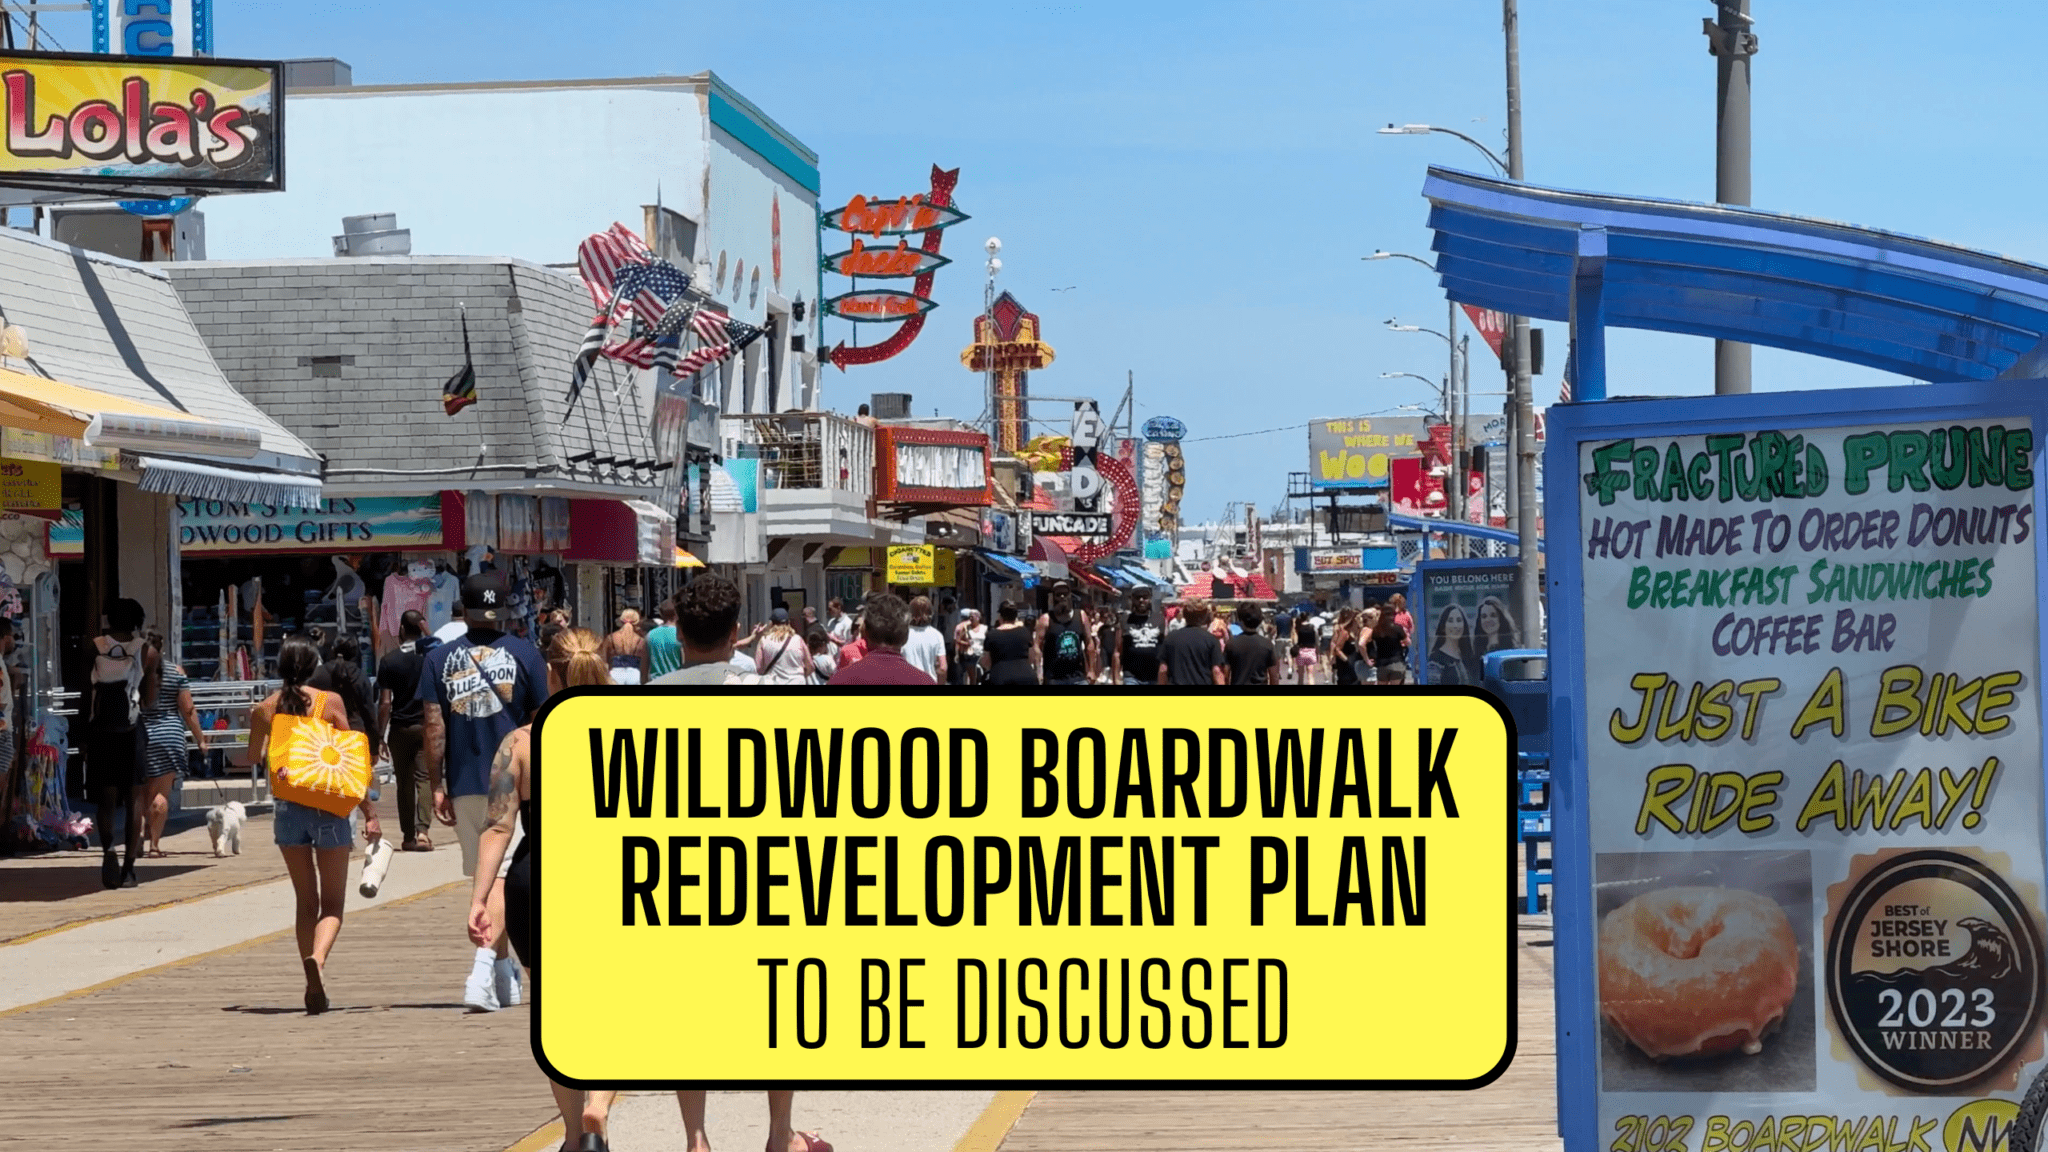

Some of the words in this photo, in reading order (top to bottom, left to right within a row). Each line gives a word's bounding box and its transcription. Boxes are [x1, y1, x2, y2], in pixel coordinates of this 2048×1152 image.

[2, 70, 252, 169] Lola's
[1344, 435, 1389, 447] WHERE
[1394, 434, 1414, 446] WE
[1358, 420, 1371, 432] IS
[1584, 430, 1829, 506] FRACTURED
[1843, 426, 2034, 495] PRUNE
[295, 520, 373, 544] GIFTS
[1588, 516, 1651, 560] HOT
[1656, 513, 1744, 559] MADE
[1751, 508, 1791, 555] TO
[1798, 506, 1902, 553] ORDER
[1907, 502, 2033, 548] DONUTS
[1430, 575, 1449, 584] YOU
[1451, 574, 1489, 583] BELONG
[1491, 573, 1514, 582] HERE
[1626, 565, 1799, 610] BREAKFAST
[1806, 557, 1995, 604] SANDWICHES
[1711, 611, 1823, 657] COFFEE
[1831, 607, 1897, 653] BAR
[1609, 671, 1782, 743] JUST
[1790, 666, 1846, 740] A
[1870, 664, 2022, 737] BIKE
[1635, 764, 1784, 835] RIDE
[1796, 756, 2001, 834] AWAY!
[1870, 919, 1948, 937] JERSEY
[1884, 905, 1918, 917] BEST
[1919, 905, 1931, 917] of
[1870, 938, 1951, 958] SHORE
[1876, 988, 1997, 1028] 2023
[1881, 1030, 1993, 1050] WINNER
[1609, 1114, 1695, 1152] 2102
[1701, 1115, 1938, 1152] BOARDWALK
